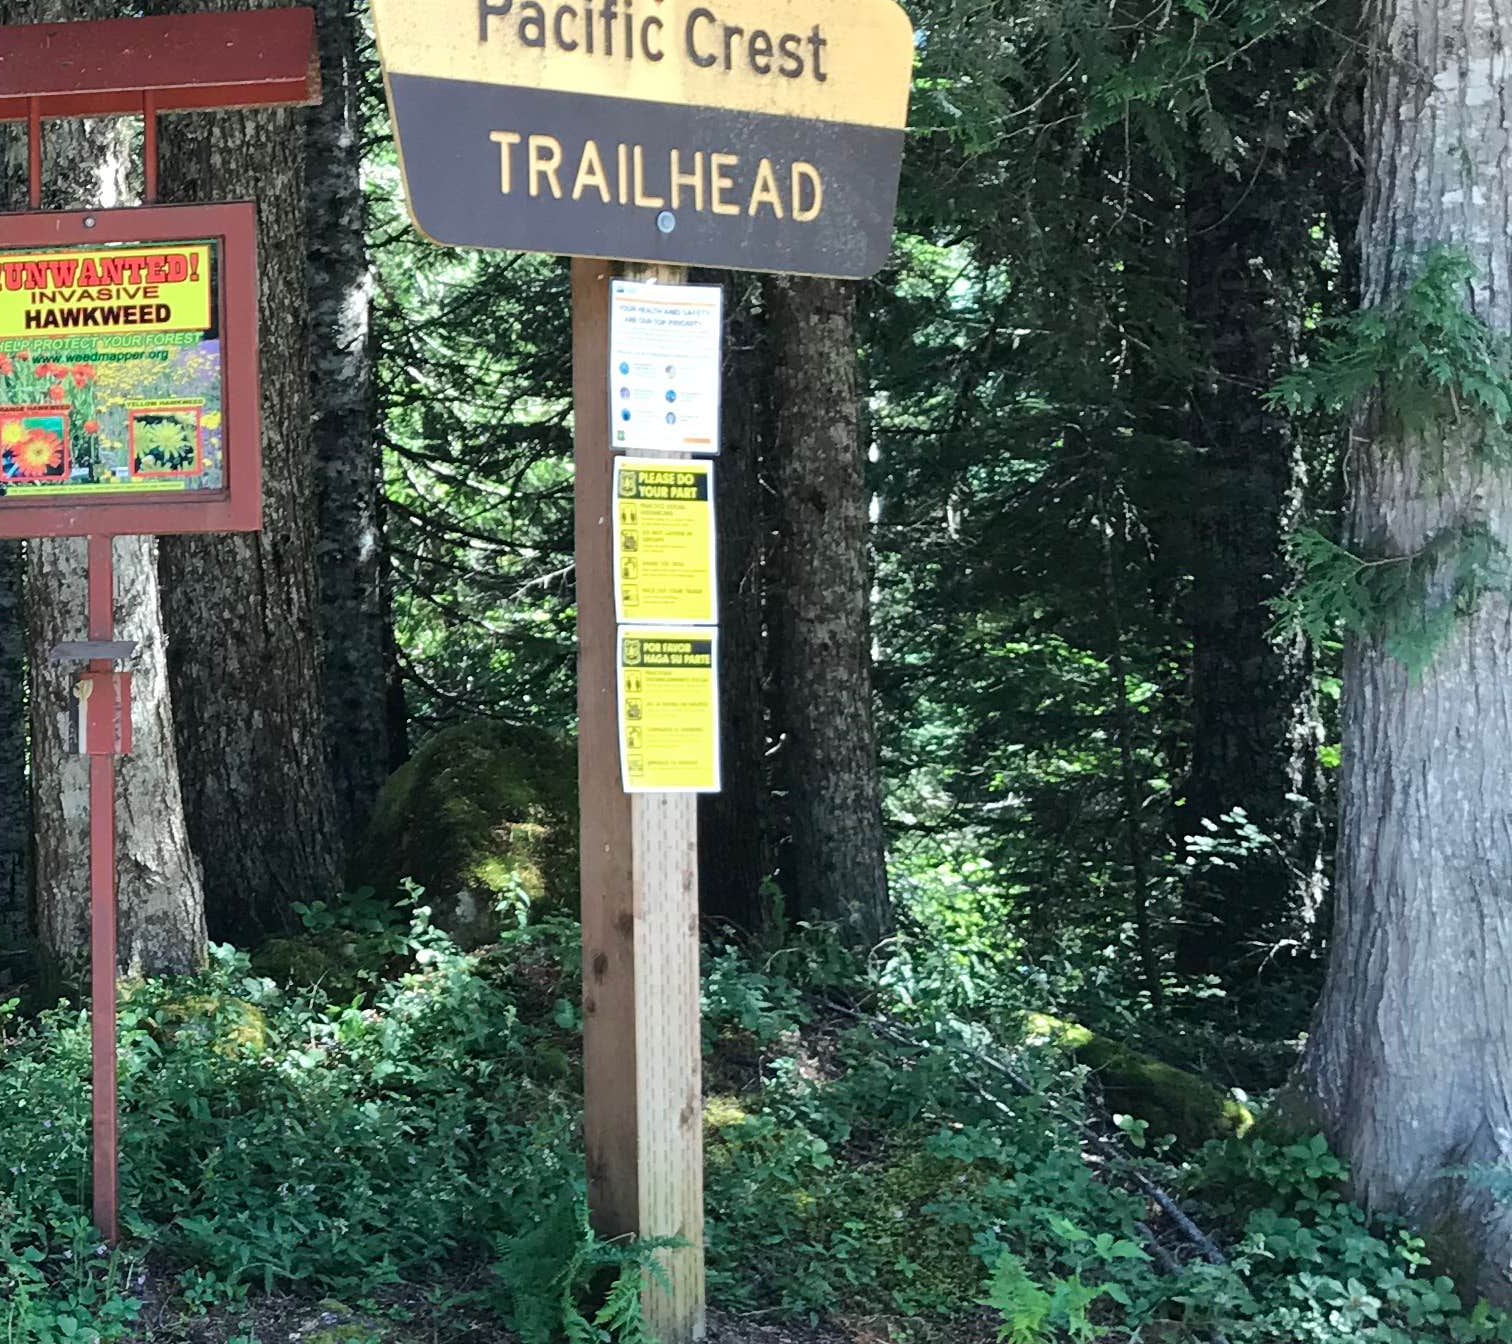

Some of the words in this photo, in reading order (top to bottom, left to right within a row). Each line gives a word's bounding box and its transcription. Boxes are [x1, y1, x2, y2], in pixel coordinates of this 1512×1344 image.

[685, 6, 828, 82] Crest
[489, 130, 823, 223] TRAILHEAD
[31, 286, 159, 304] INVASIVE
[25, 303, 171, 329] HAWKWEED
[32, 336, 97, 350] PROTECT
[103, 334, 142, 347] YOUR
[145, 331, 205, 345] FOREST
[638, 471, 675, 485] PLEASE
[677, 474, 695, 486] DO
[639, 485, 669, 498] YOUR
[670, 486, 698, 499] PART
